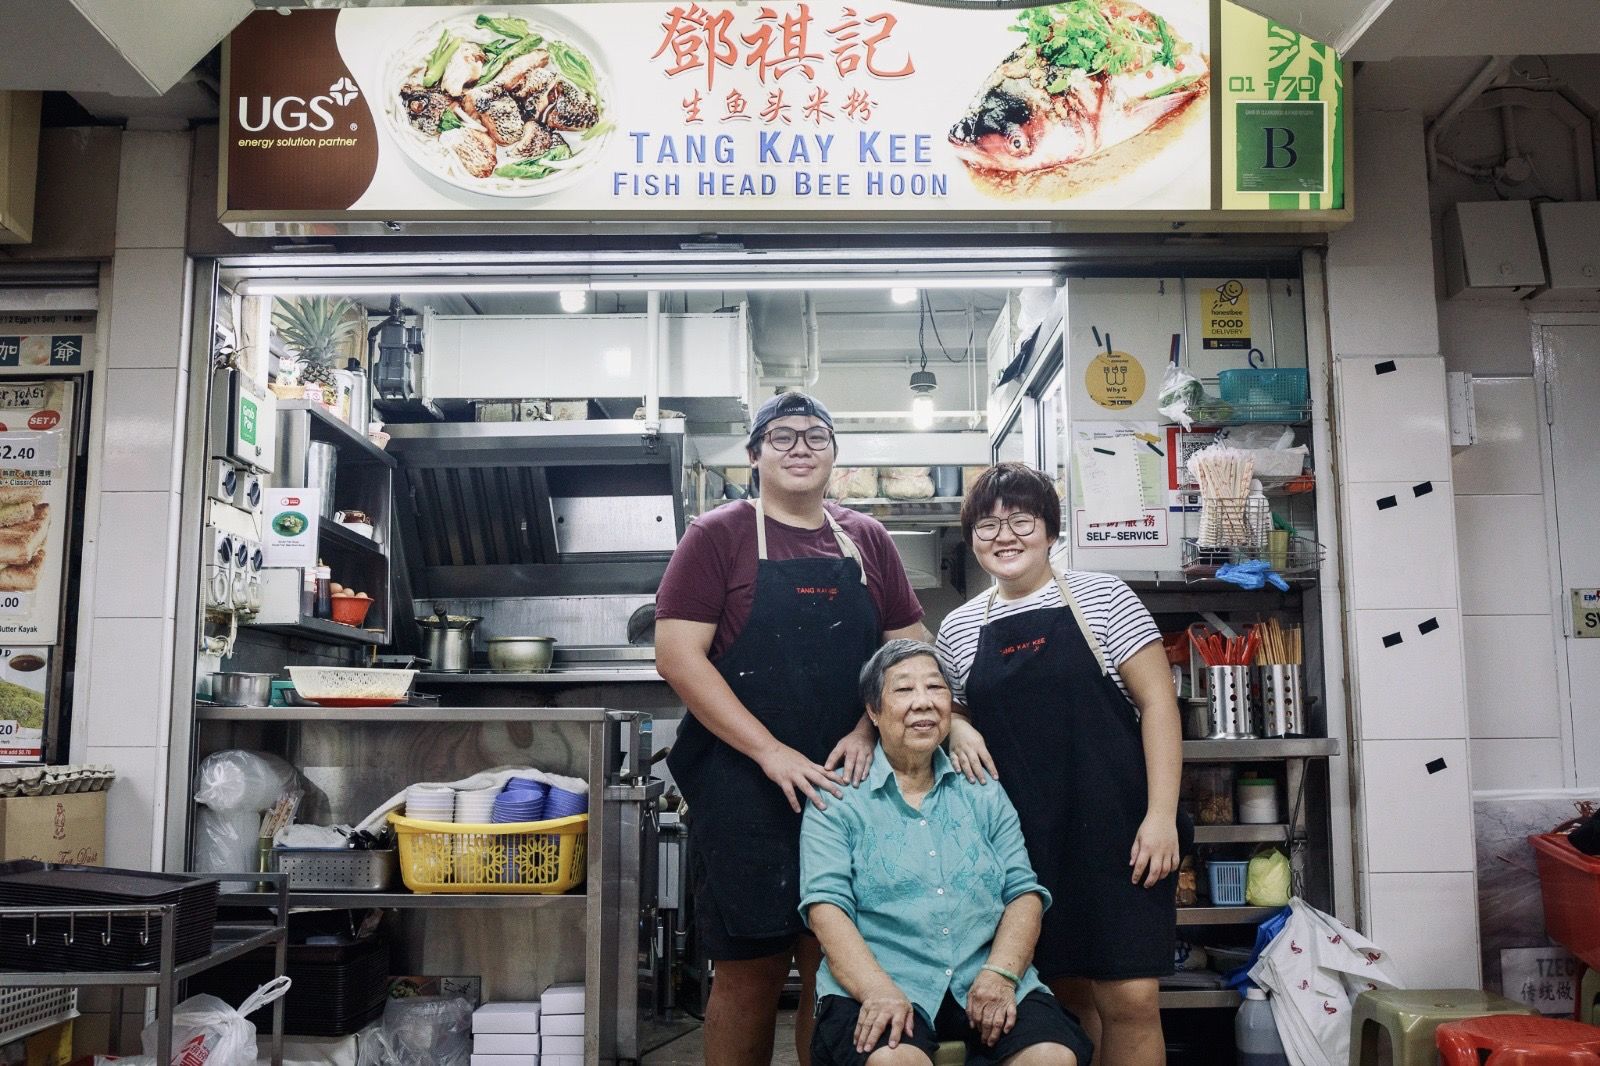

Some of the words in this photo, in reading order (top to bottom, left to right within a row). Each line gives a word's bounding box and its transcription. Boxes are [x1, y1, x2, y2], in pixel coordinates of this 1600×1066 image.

[651, 3, 916, 91] 鄧祺記
[239, 96, 334, 131] UGS
[682, 88, 879, 125] 生鱼头米粉
[238, 139, 274, 148] energy
[277, 137, 315, 147] solution
[318, 137, 358, 148] partner
[630, 131, 735, 163] TANG
[760, 131, 834, 163] KAY
[859, 131, 932, 163] KEE
[1262, 127, 1298, 169] B
[613, 172, 680, 195] FISH
[700, 172, 776, 195] HEAD
[795, 172, 850, 195] BEE
[867, 172, 947, 195] HOON
[1211, 320, 1244, 328] FOOD
[29, 417, 49, 425] SET
[49, 416, 57, 424] A
[0, 445, 35, 460] 2.40
[1086, 531, 1159, 541] SELF-SERVICE
[19, 625, 38, 634] Kayak
